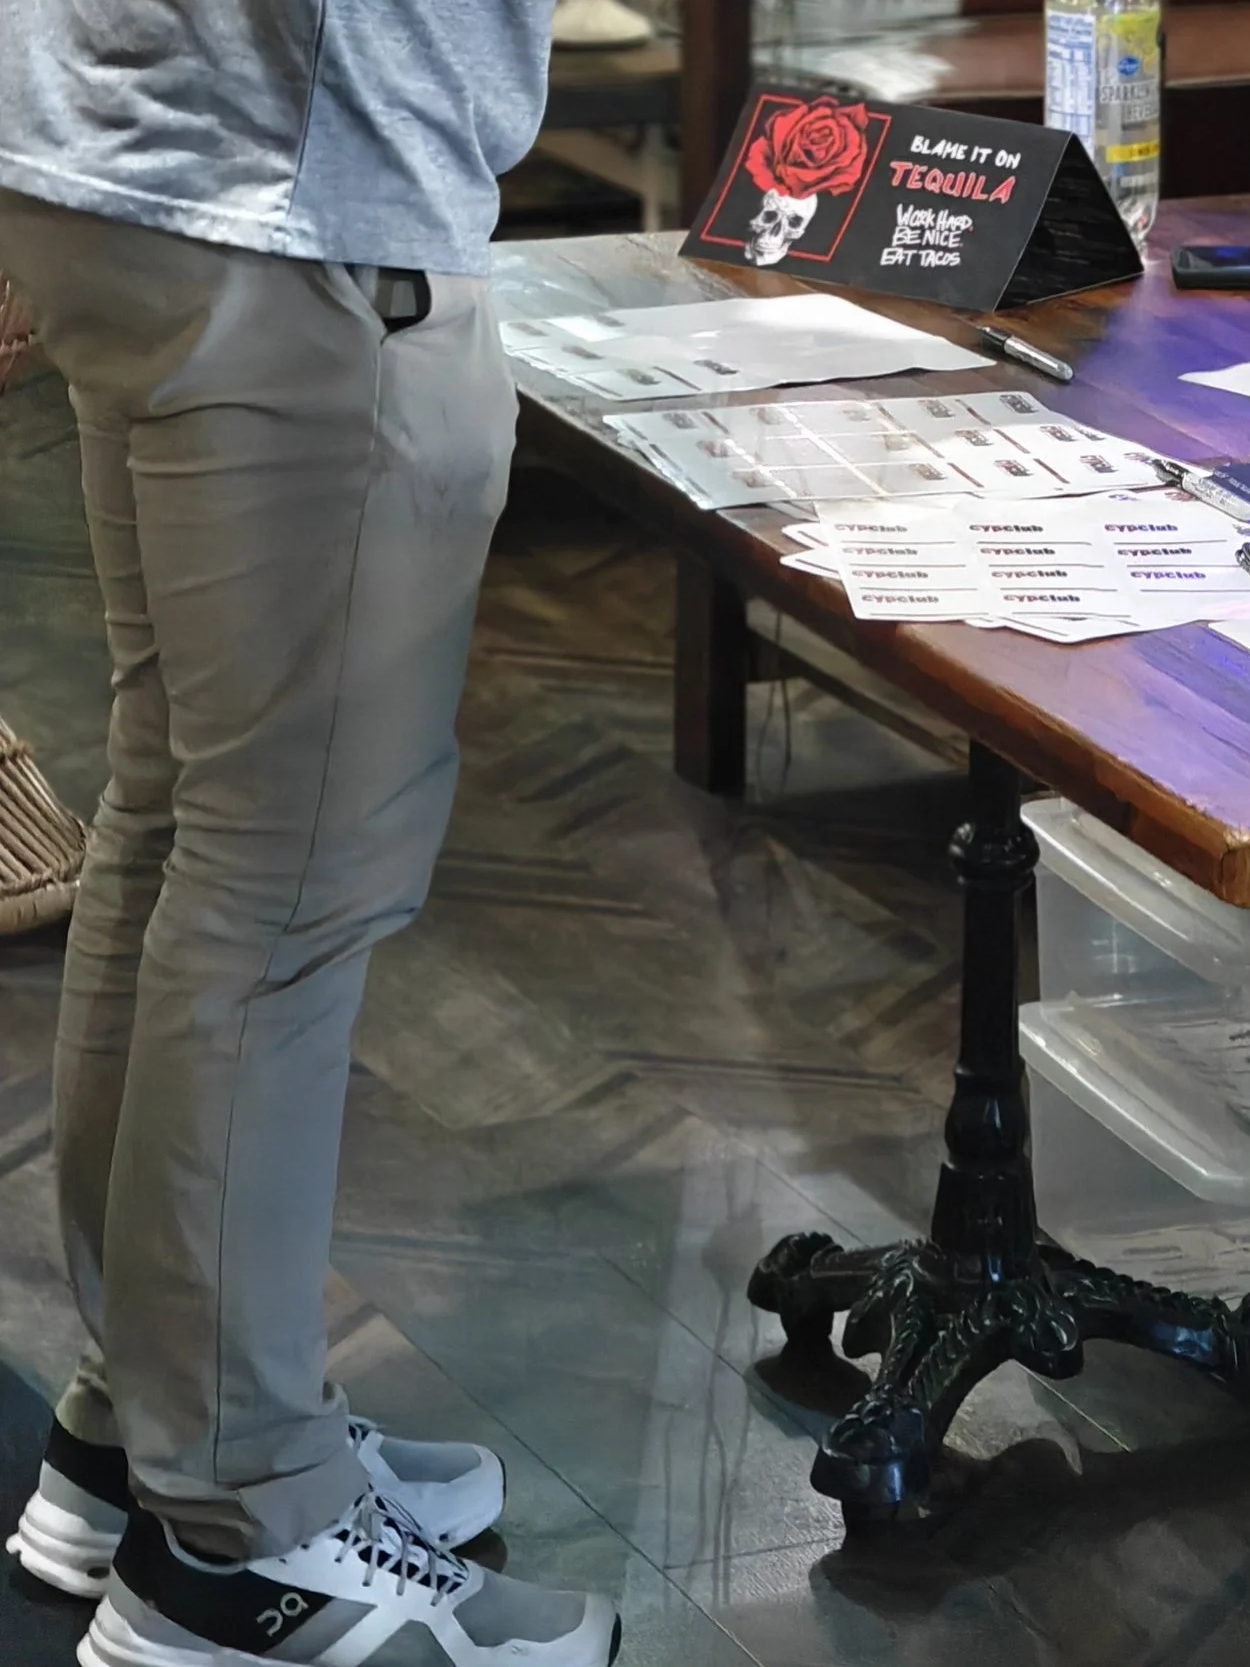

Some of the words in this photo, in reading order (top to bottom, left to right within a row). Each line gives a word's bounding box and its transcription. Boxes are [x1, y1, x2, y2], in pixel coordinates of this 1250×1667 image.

[911, 135, 968, 160] BLAME
[970, 145, 992, 164] IT
[995, 150, 1021, 169] ON
[890, 161, 1016, 204] TEQUILA
[892, 226, 920, 247] BE
[880, 247, 918, 267] EAT
[969, 523, 1044, 533] cypclub
[1104, 522, 1178, 533] cypclub
[1130, 570, 1206, 580] cypclub
[1003, 593, 1081, 603] cypclub
